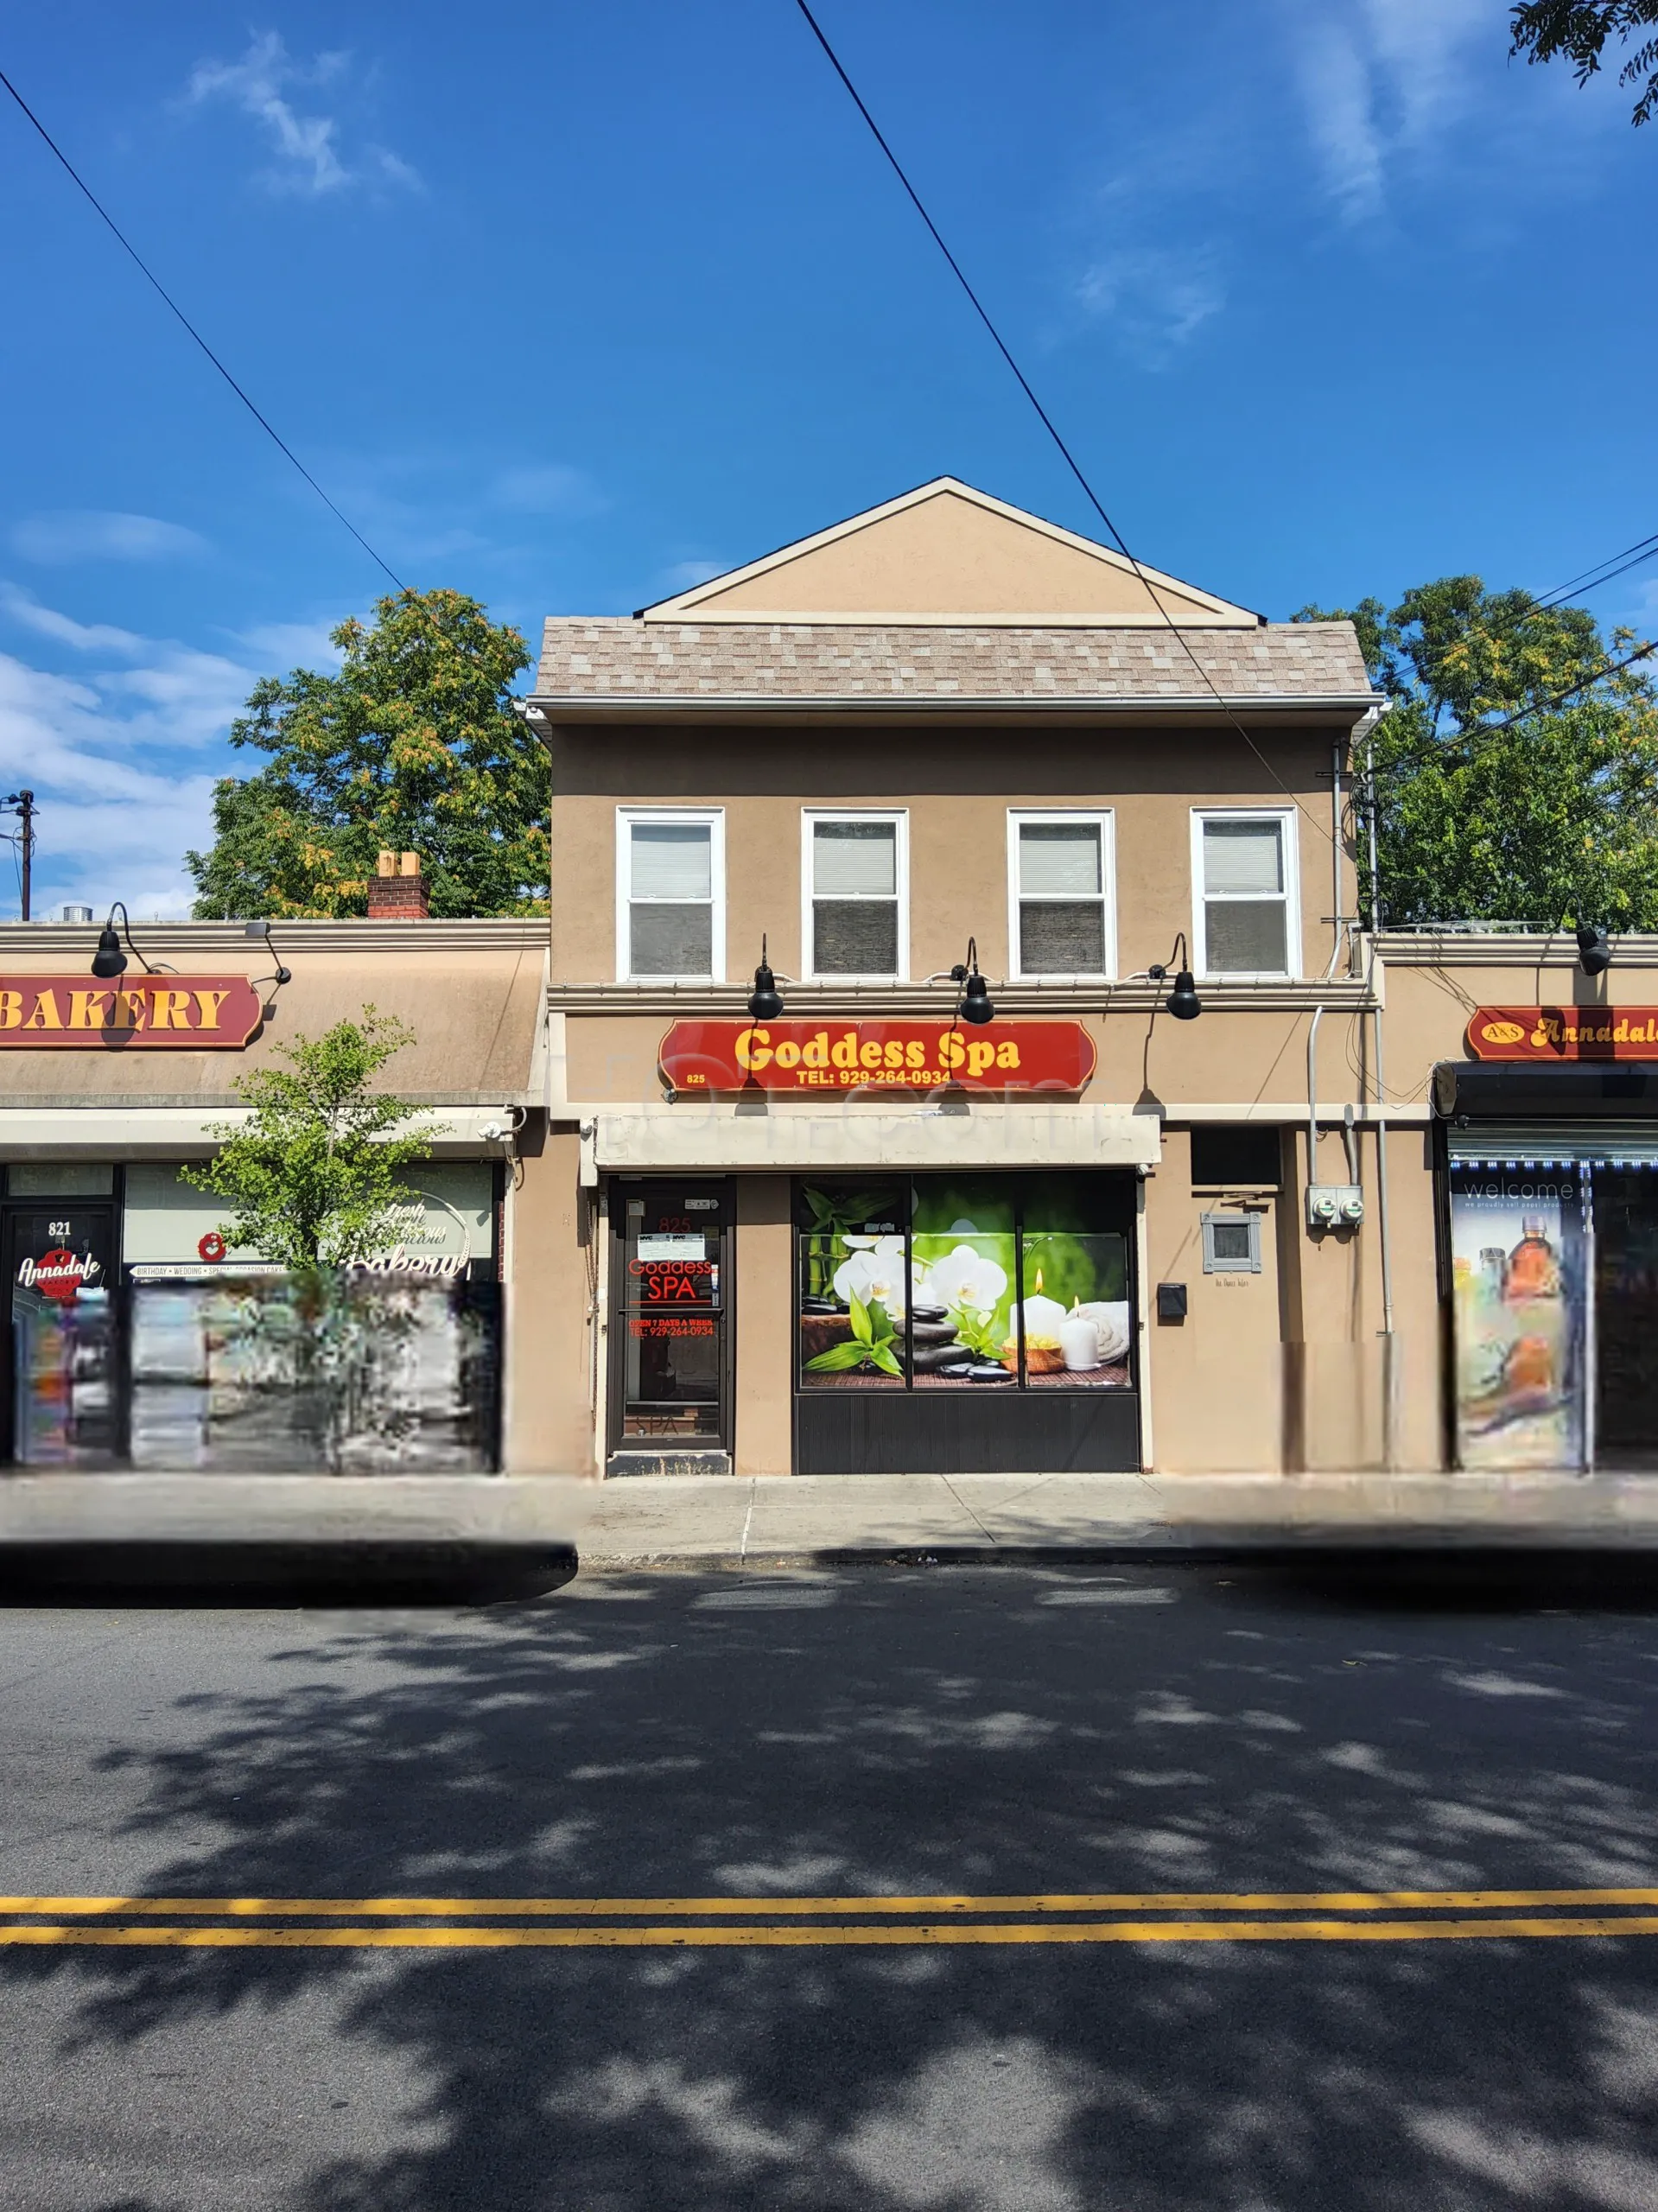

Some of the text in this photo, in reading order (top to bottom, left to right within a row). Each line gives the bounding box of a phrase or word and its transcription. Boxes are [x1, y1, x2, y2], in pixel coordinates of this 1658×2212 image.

[0, 988, 232, 1033] BAKERY
[1486, 1018, 1658, 1048] A&S Annadal
[734, 1028, 1021, 1077] Goddess Spa
[686, 1074, 706, 1084] 825
[796, 1071, 950, 1084] TEL: 929-264-0934
[1464, 1177, 1574, 1199] welcome
[48, 1221, 72, 1236] 821
[658, 1217, 691, 1233] 825
[18, 1253, 101, 1287] Annadale
[137, 1267, 167, 1275] BIRTHDAY
[628, 1258, 712, 1274] Goddess
[648, 1276, 696, 1300] SPA
[630, 1326, 714, 1337] TEL: 929-264-0934
